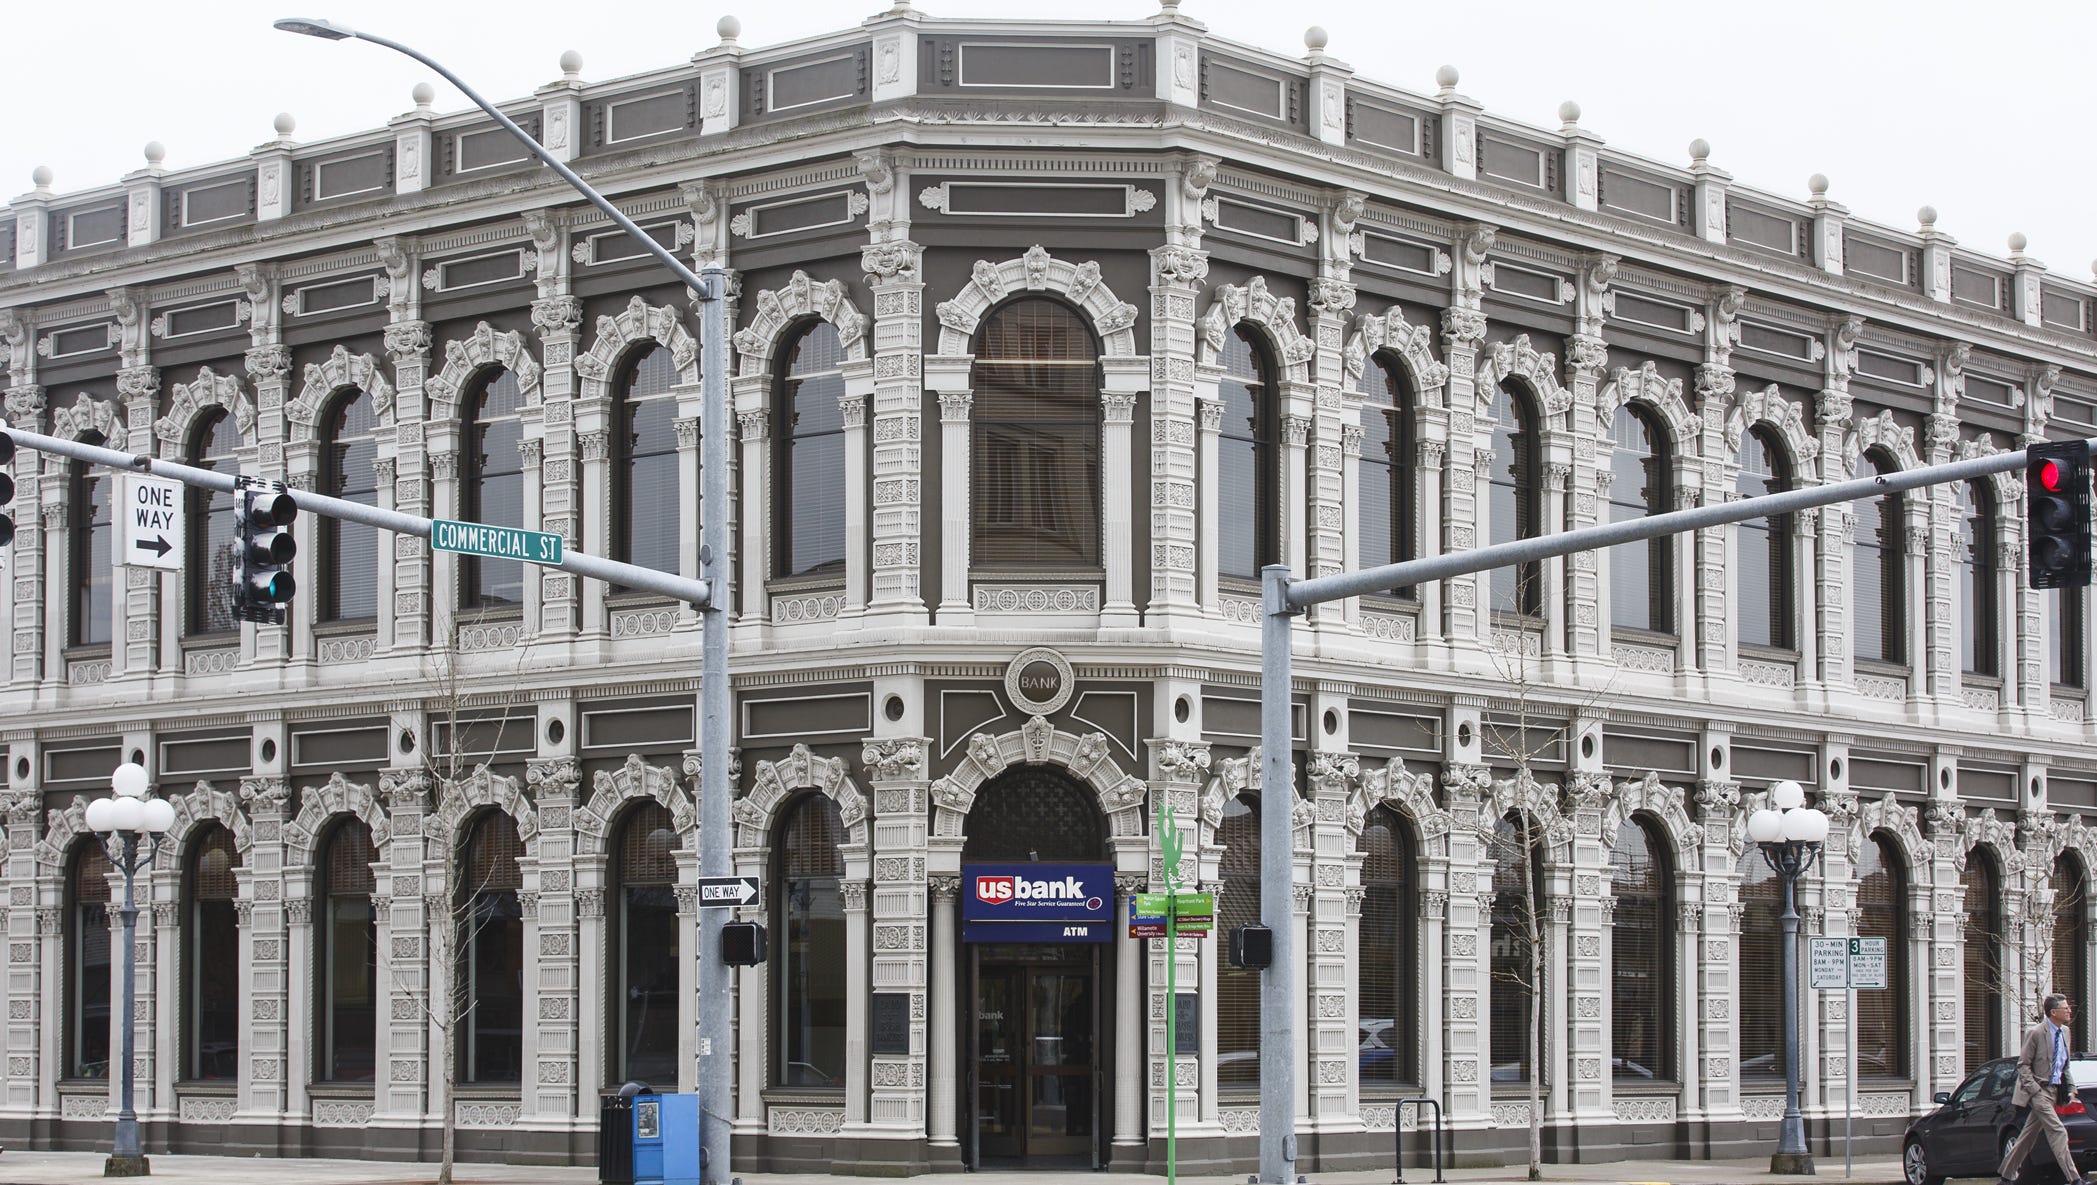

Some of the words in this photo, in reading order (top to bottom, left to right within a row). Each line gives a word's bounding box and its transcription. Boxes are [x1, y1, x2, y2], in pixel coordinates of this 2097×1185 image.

[138, 485, 172, 507] ONE
[136, 508, 174, 530] WAY
[439, 523, 530, 557] COMMERCIAL
[540, 535, 557, 560] ST
[1021, 676, 1058, 689] BANK
[704, 886, 720, 898] ONE
[722, 886, 740, 898] WAY
[1063, 926, 1088, 936] ATM
[1851, 940, 1859, 953] 3
[978, 1010, 1004, 1020] bank
